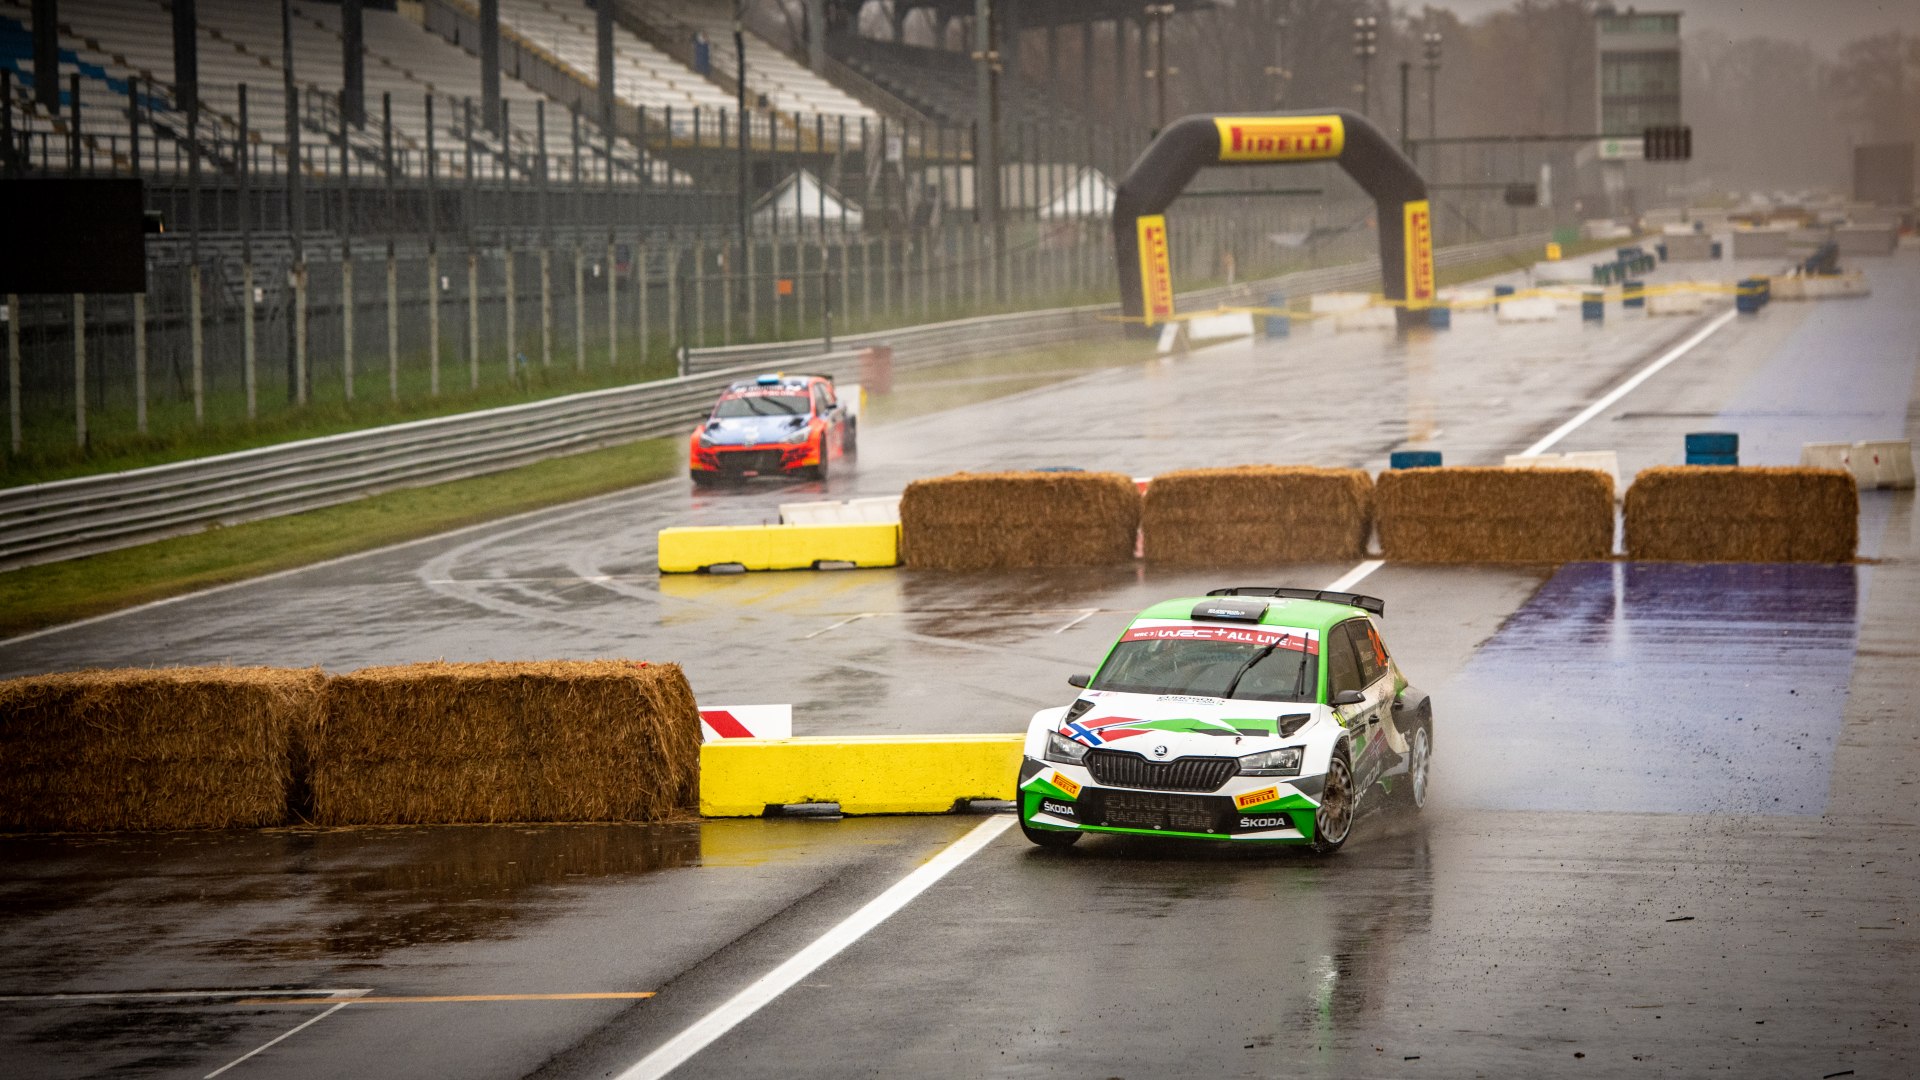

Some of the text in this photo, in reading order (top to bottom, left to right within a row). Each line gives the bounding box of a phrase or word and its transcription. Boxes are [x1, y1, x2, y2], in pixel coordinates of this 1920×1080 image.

[1231, 126, 1332, 151] PIRELLI
[1146, 227, 1169, 316] PIRELLI
[1227, 632, 1253, 641] ALL
[1257, 635, 1289, 646] LIVE
[1054, 775, 1077, 794] PIRELLI
[1240, 790, 1275, 806] PIRELLI
[1043, 801, 1074, 815] ŠKODA
[1240, 817, 1285, 827] ŠKODA
